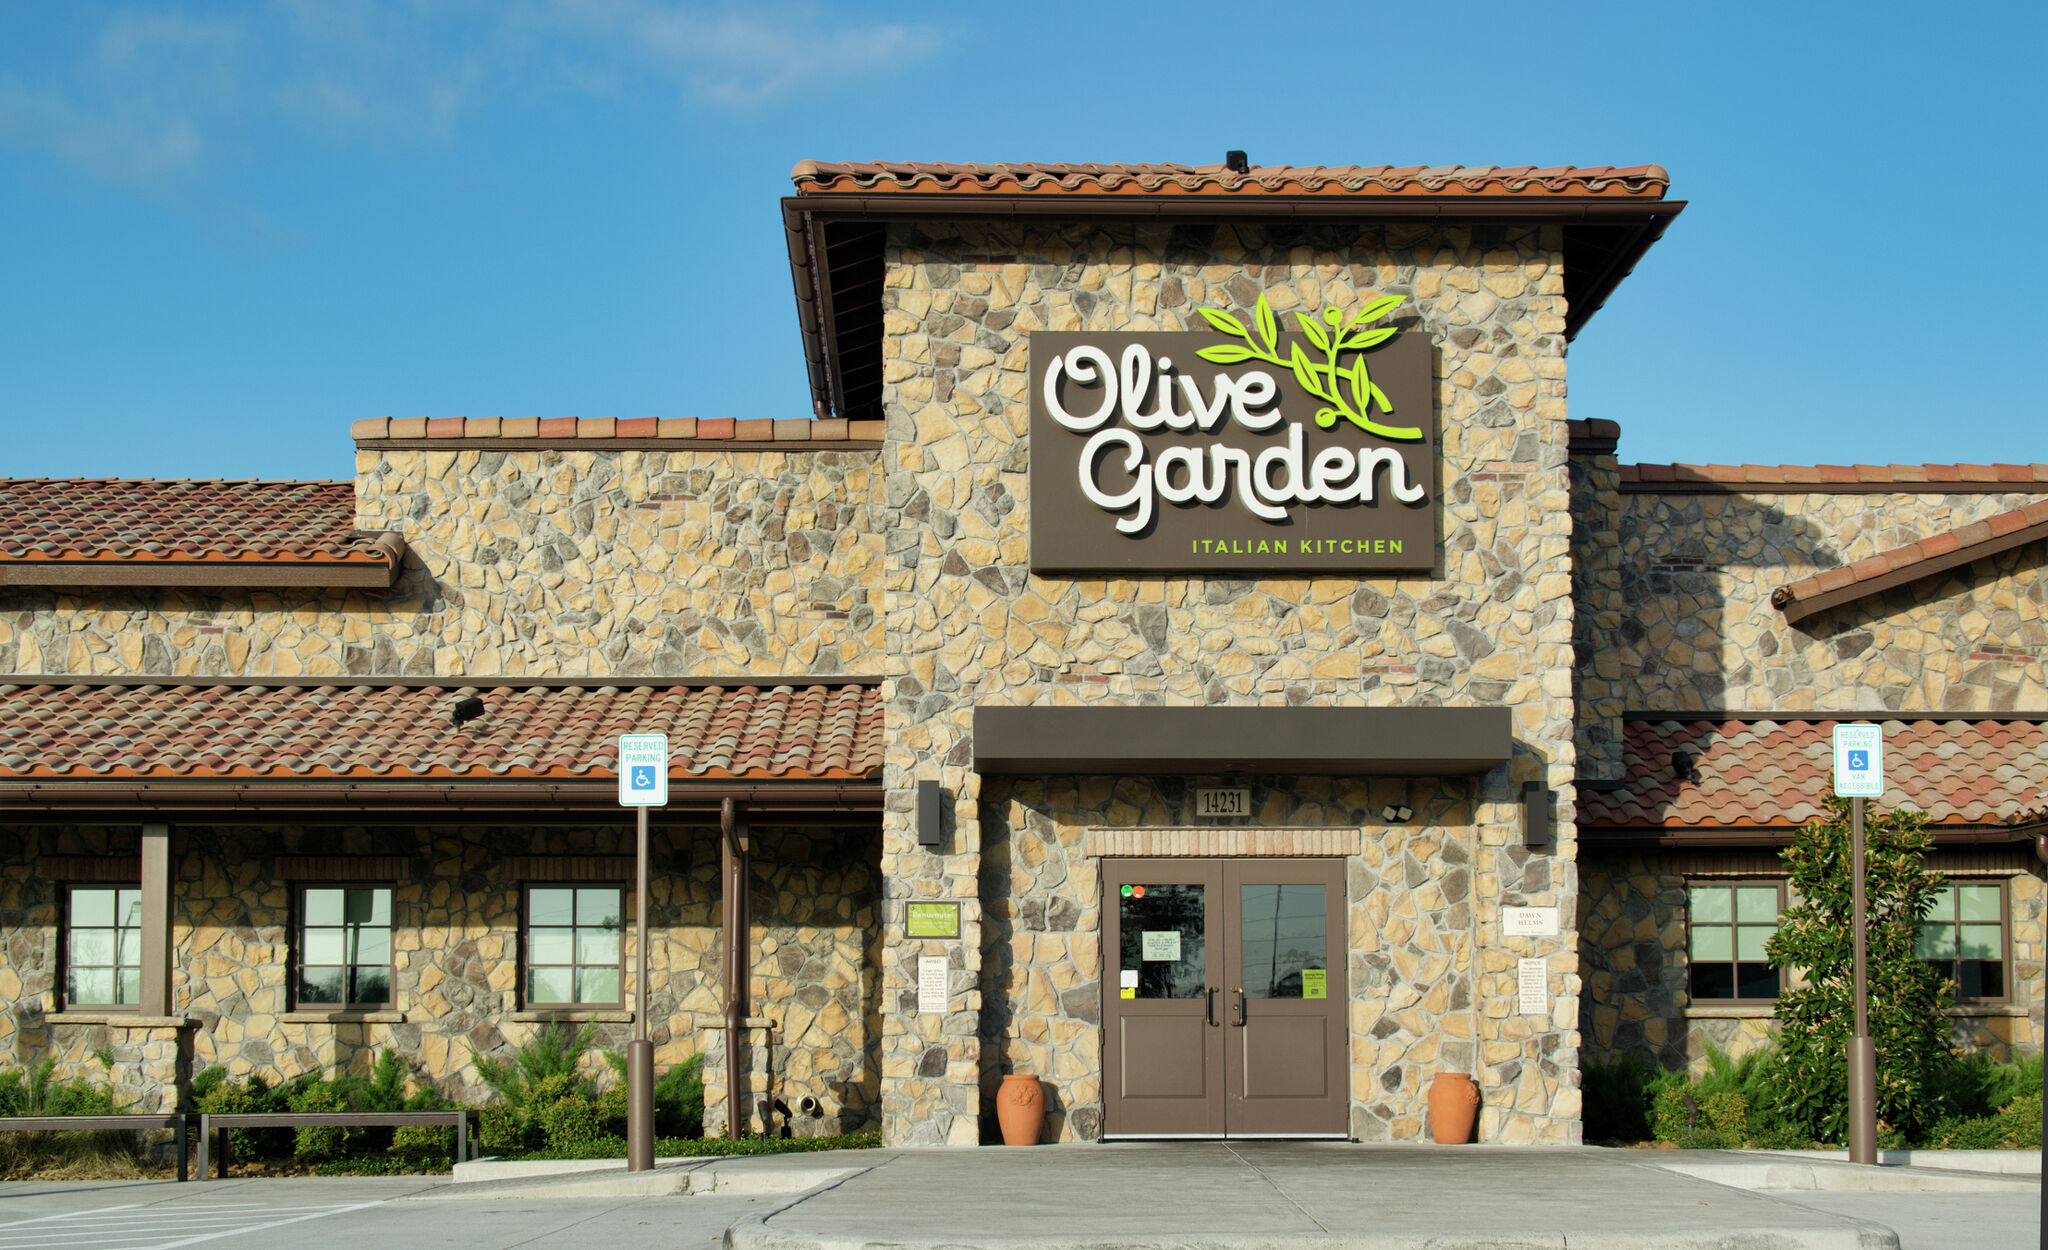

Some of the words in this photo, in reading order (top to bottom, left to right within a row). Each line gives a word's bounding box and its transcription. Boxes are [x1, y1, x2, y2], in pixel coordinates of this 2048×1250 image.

[1044, 344, 1281, 431] Olive
[1078, 422, 1424, 534] Garden
[1192, 540, 1288, 554] ITALIAN
[1300, 540, 1403, 554] KITCHEN
[1840, 731, 1875, 739] RESERVED
[623, 741, 664, 751] RESERVED
[625, 753, 662, 762] PARKING
[1839, 782, 1879, 790] ACCESSIBLE
[1203, 791, 1243, 813] 14231
